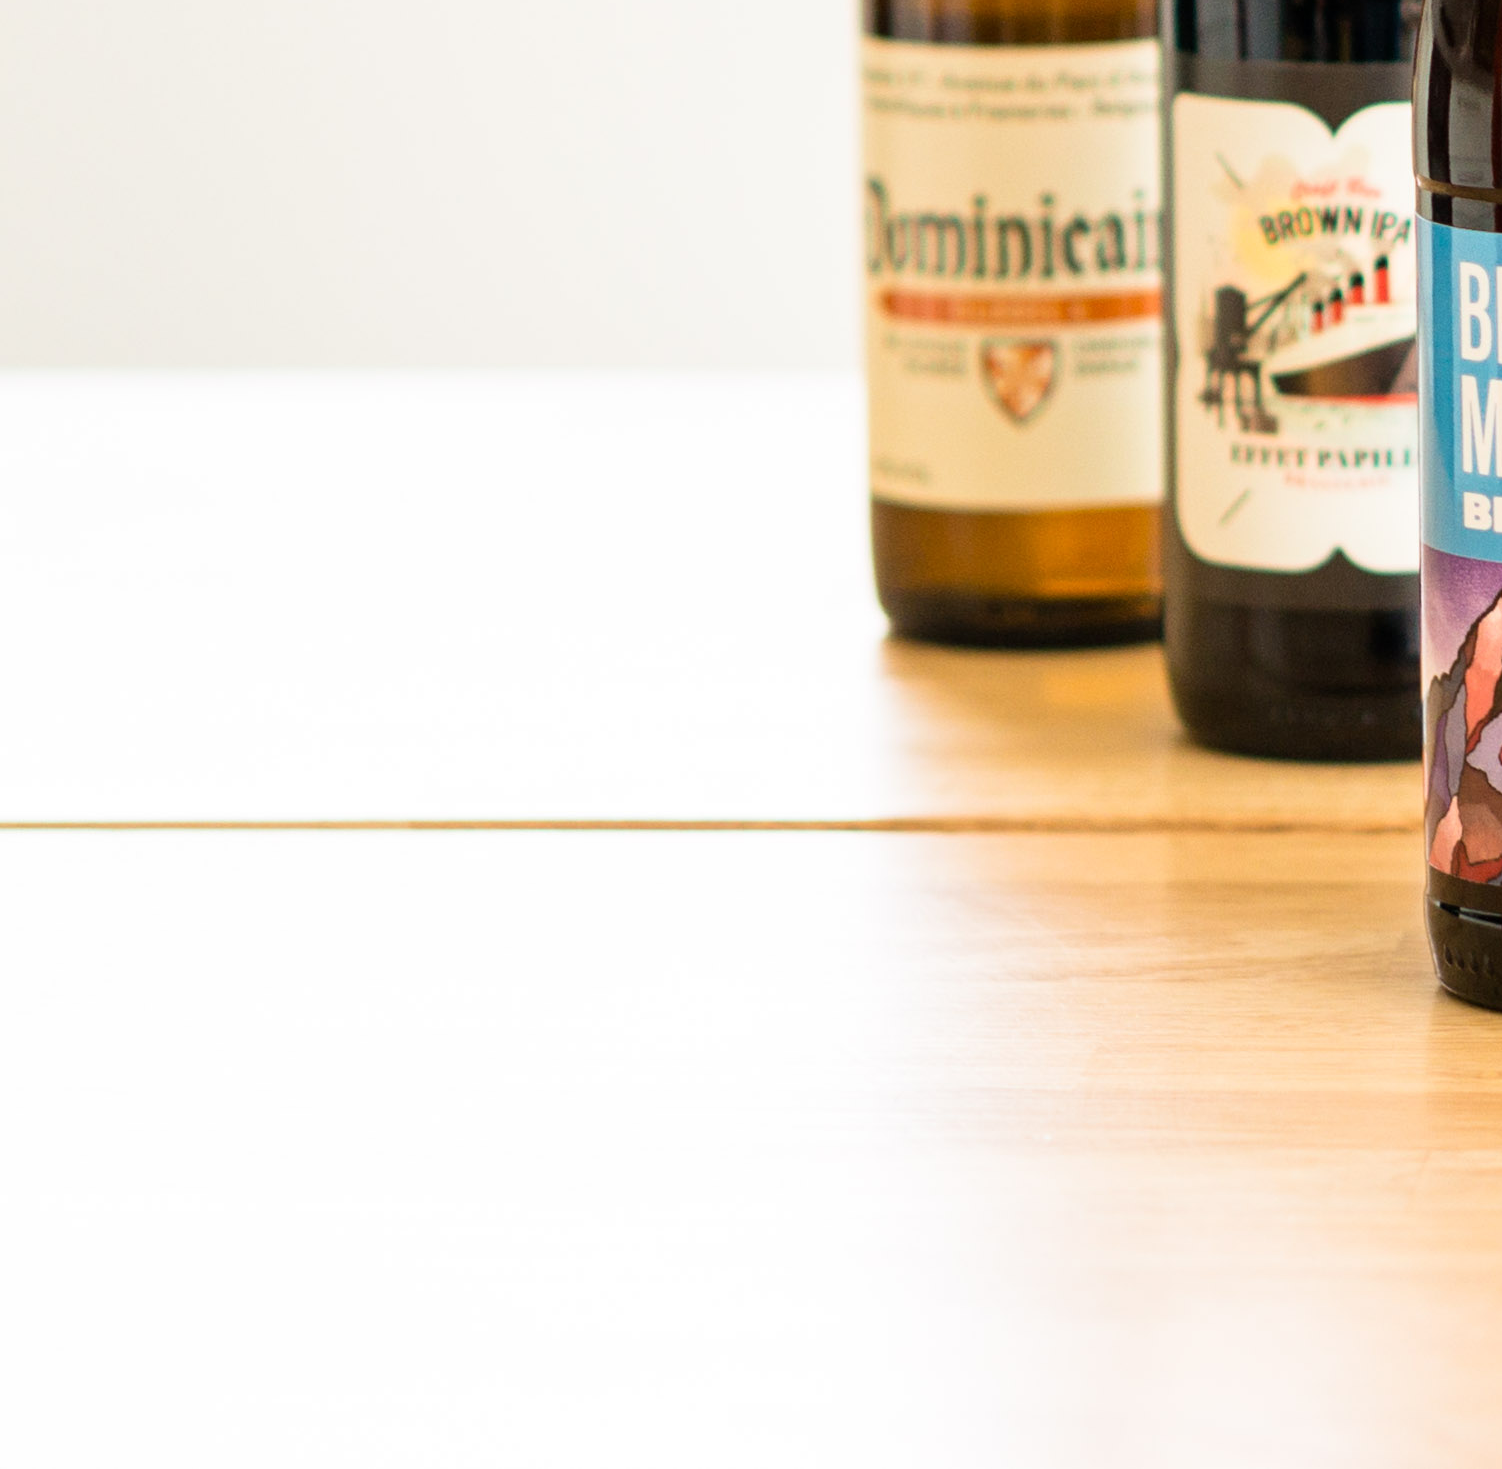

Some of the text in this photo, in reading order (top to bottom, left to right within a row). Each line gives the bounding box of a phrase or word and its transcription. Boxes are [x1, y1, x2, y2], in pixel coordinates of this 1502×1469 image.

[866, 176, 1168, 280] Dominicai
[1260, 204, 1413, 246] BROWN IPA
